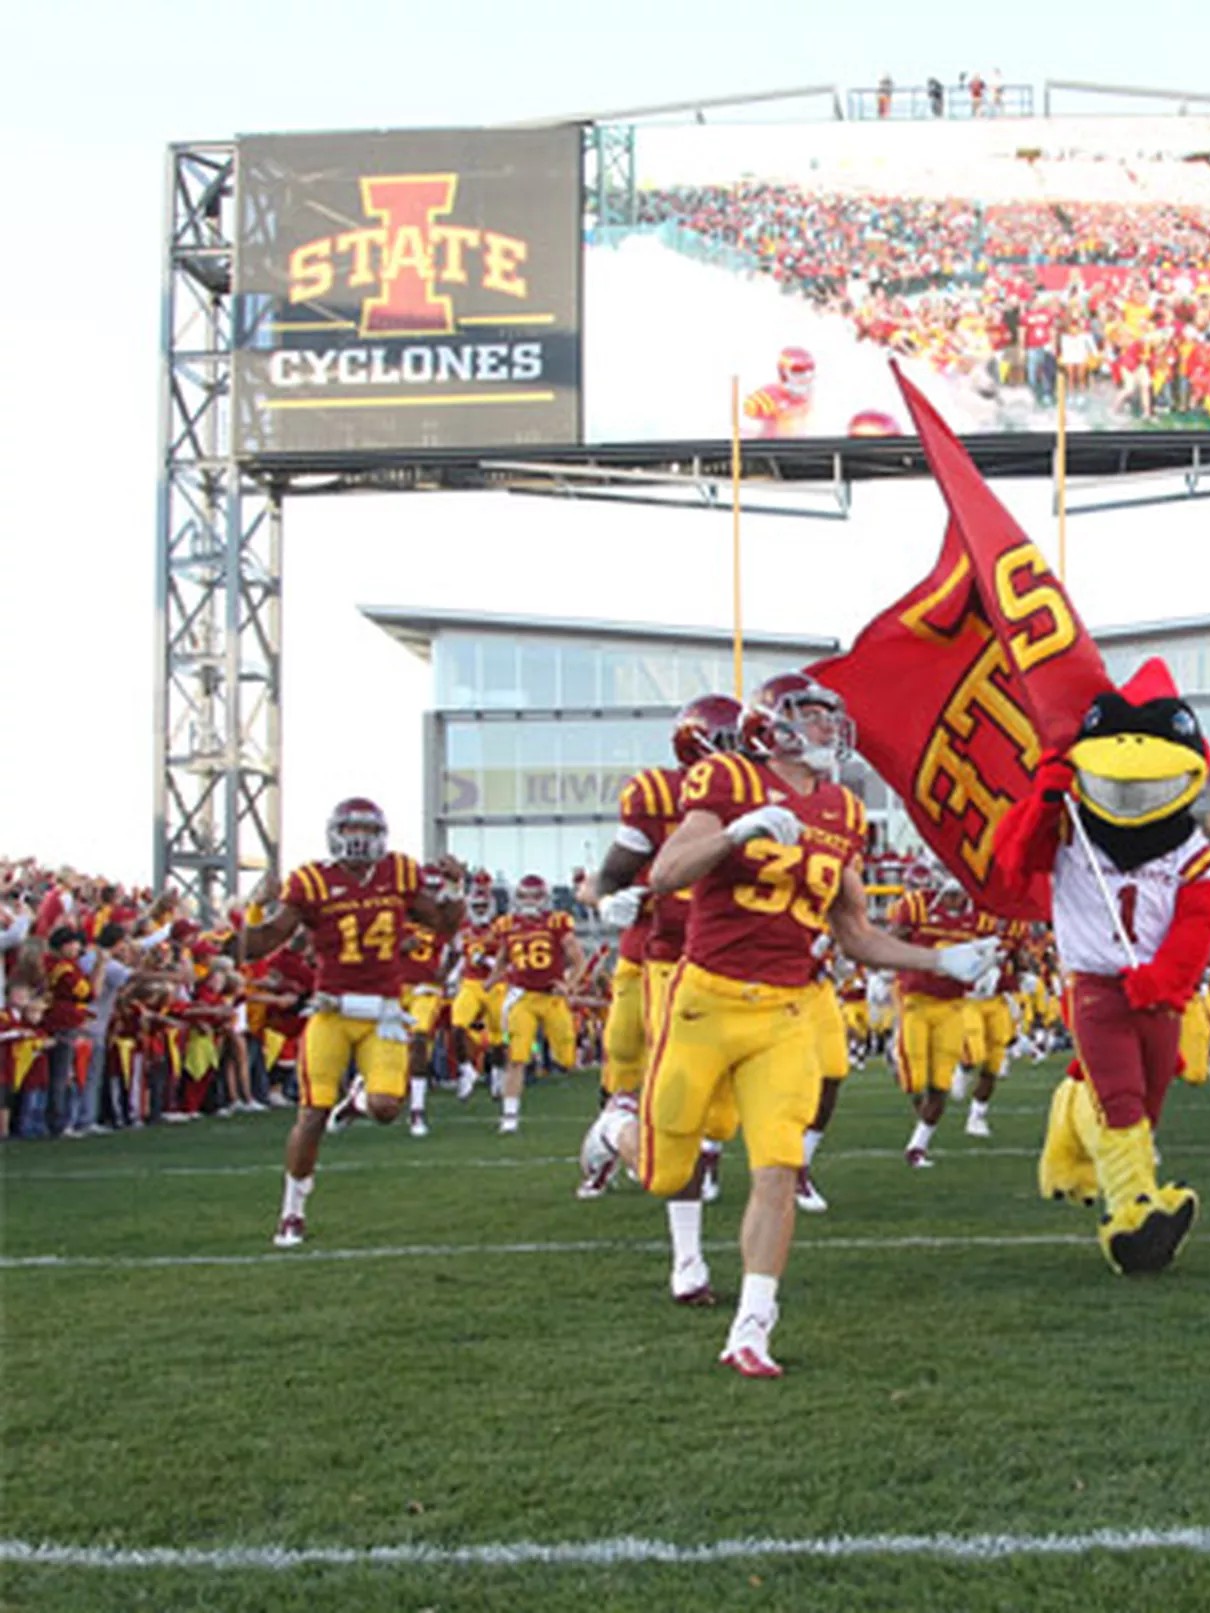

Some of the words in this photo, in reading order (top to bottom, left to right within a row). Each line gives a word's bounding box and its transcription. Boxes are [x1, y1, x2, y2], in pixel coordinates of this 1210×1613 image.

[288, 224, 527, 304] STATE
[269, 343, 543, 387] CYCLONES
[733, 837, 843, 932] 39
[337, 910, 396, 964] 14
[511, 938, 552, 971] 46
